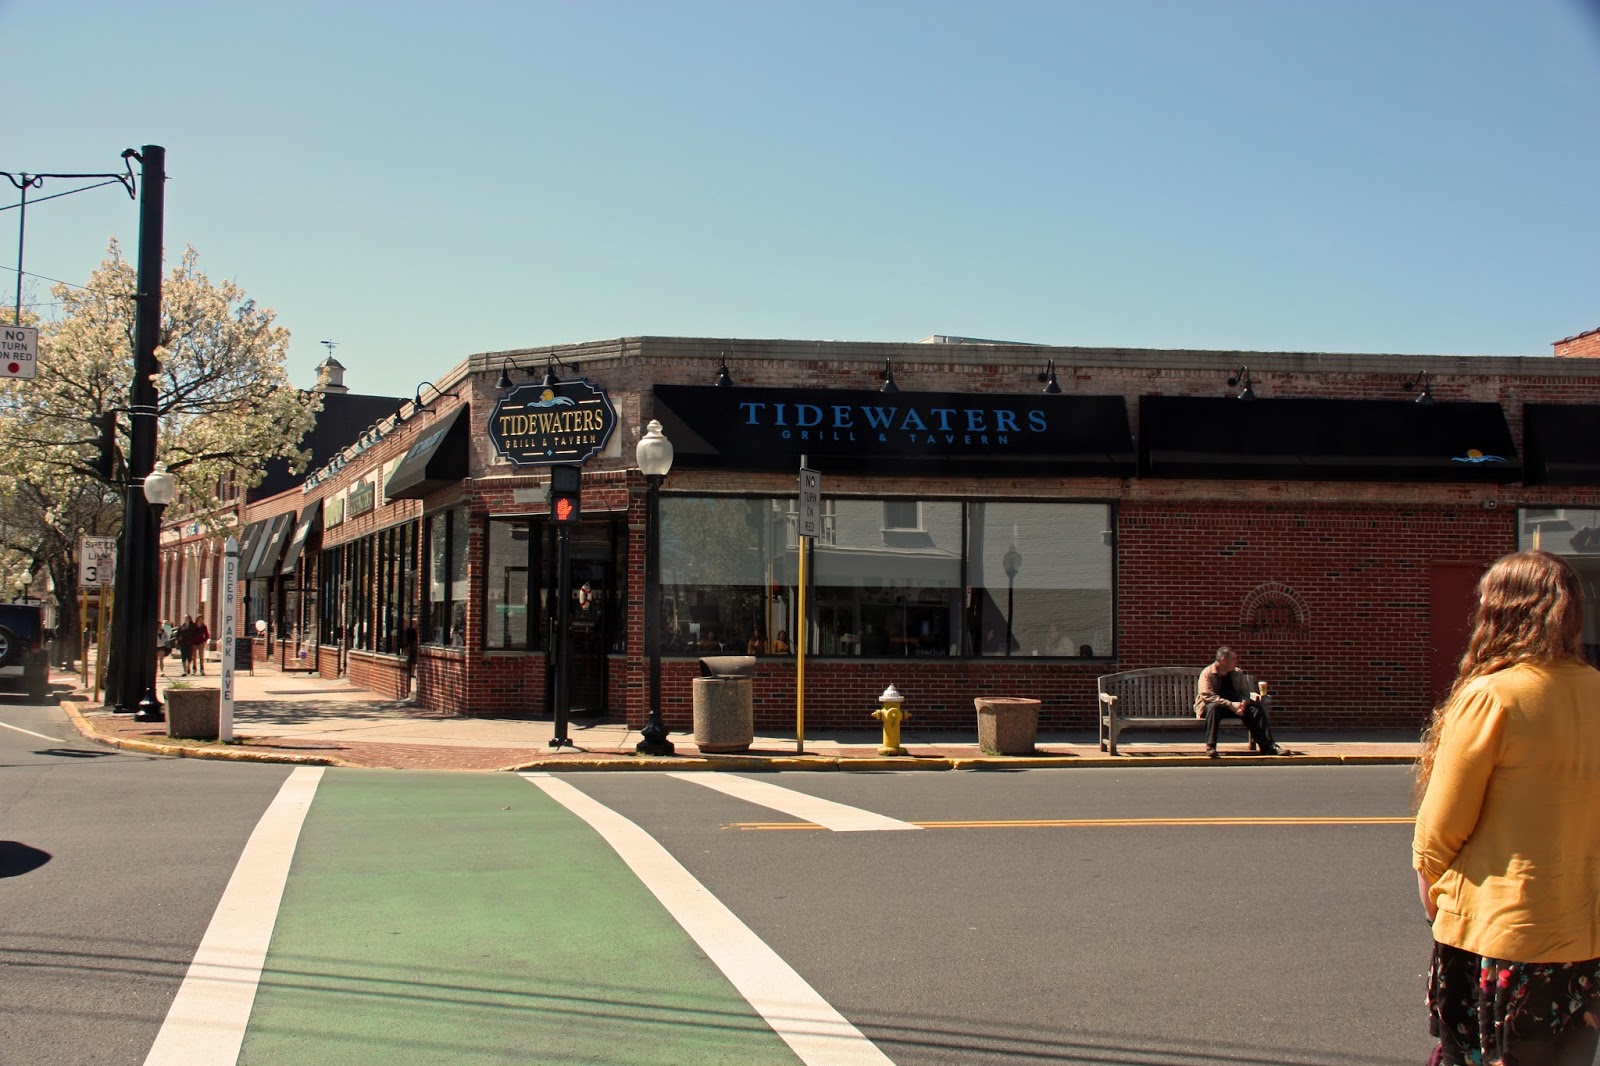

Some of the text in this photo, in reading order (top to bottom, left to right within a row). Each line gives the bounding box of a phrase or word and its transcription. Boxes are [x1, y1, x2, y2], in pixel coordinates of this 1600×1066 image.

[5, 330, 25, 341] NO
[1, 341, 28, 351] TURN
[13, 352, 33, 361] RED
[500, 409, 603, 437] TIDEWATERS
[739, 402, 1048, 433] TIDEWATERS
[505, 439, 536, 448] GRILL
[554, 435, 596, 446] TAVERN
[782, 429, 1008, 445] GRILL & TAVERN
[806, 475, 815, 488] NO
[804, 491, 817, 503] TURN
[805, 521, 815, 532] RED
[85, 541, 117, 549] SPEED
[225, 615, 233, 657] PARK
